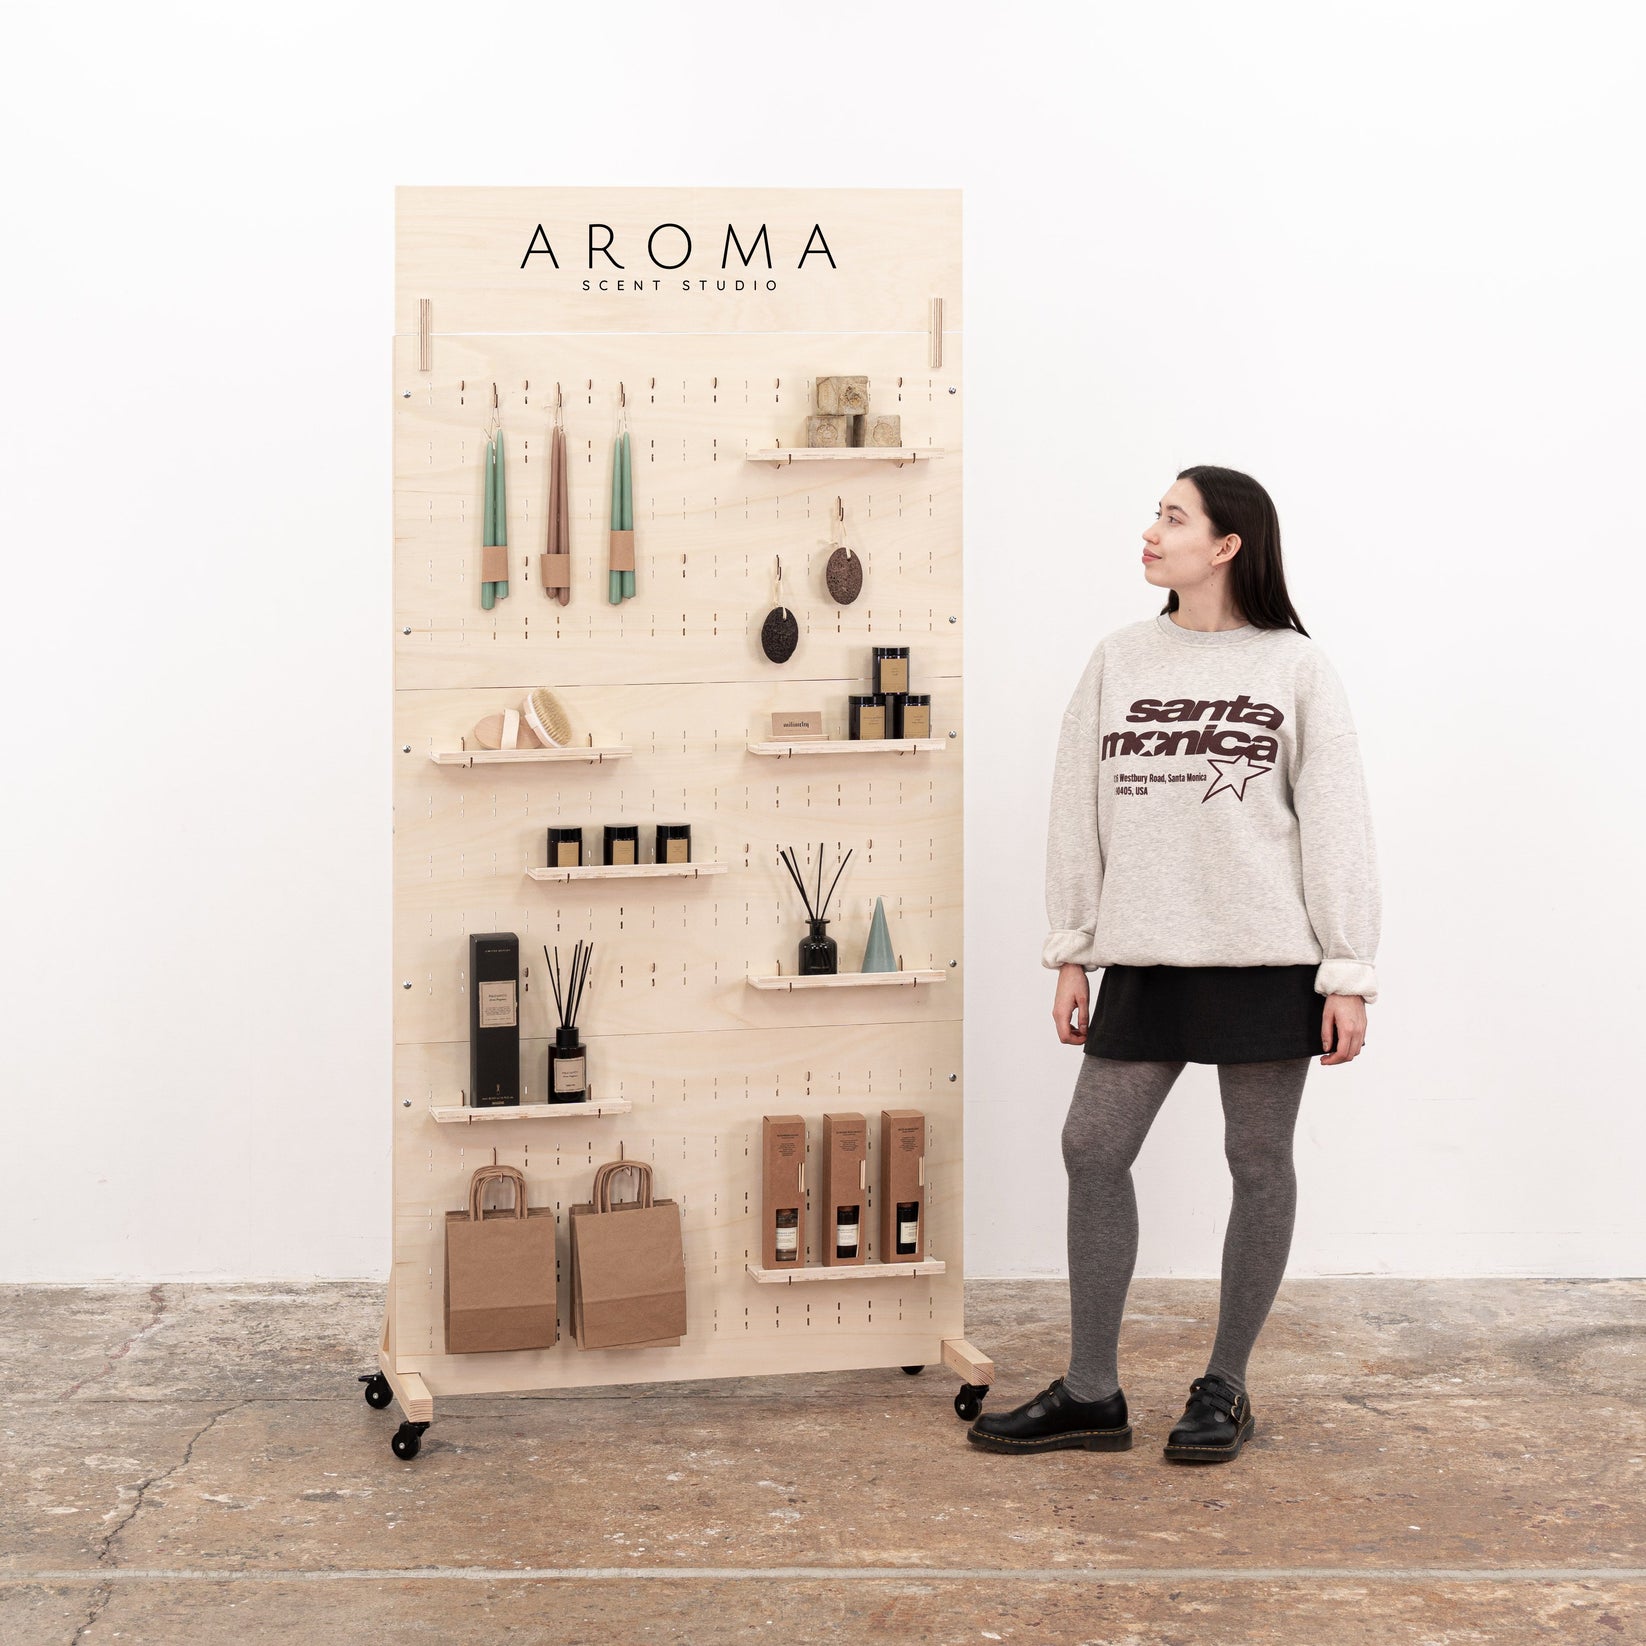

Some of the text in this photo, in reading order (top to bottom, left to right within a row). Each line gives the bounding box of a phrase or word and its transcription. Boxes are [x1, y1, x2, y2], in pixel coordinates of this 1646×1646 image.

[520, 223, 836, 269] AROMA
[583, 280, 776, 290] SCENT STUDIO
[1126, 695, 1284, 730] santa
[1101, 724, 1278, 763] monica
[1119, 773, 1148, 784] Westbury
[1149, 773, 1167, 784] Road,
[1168, 773, 1186, 783] Santa
[1186, 772, 1207, 782] Monica
[1135, 786, 1149, 796] USA
